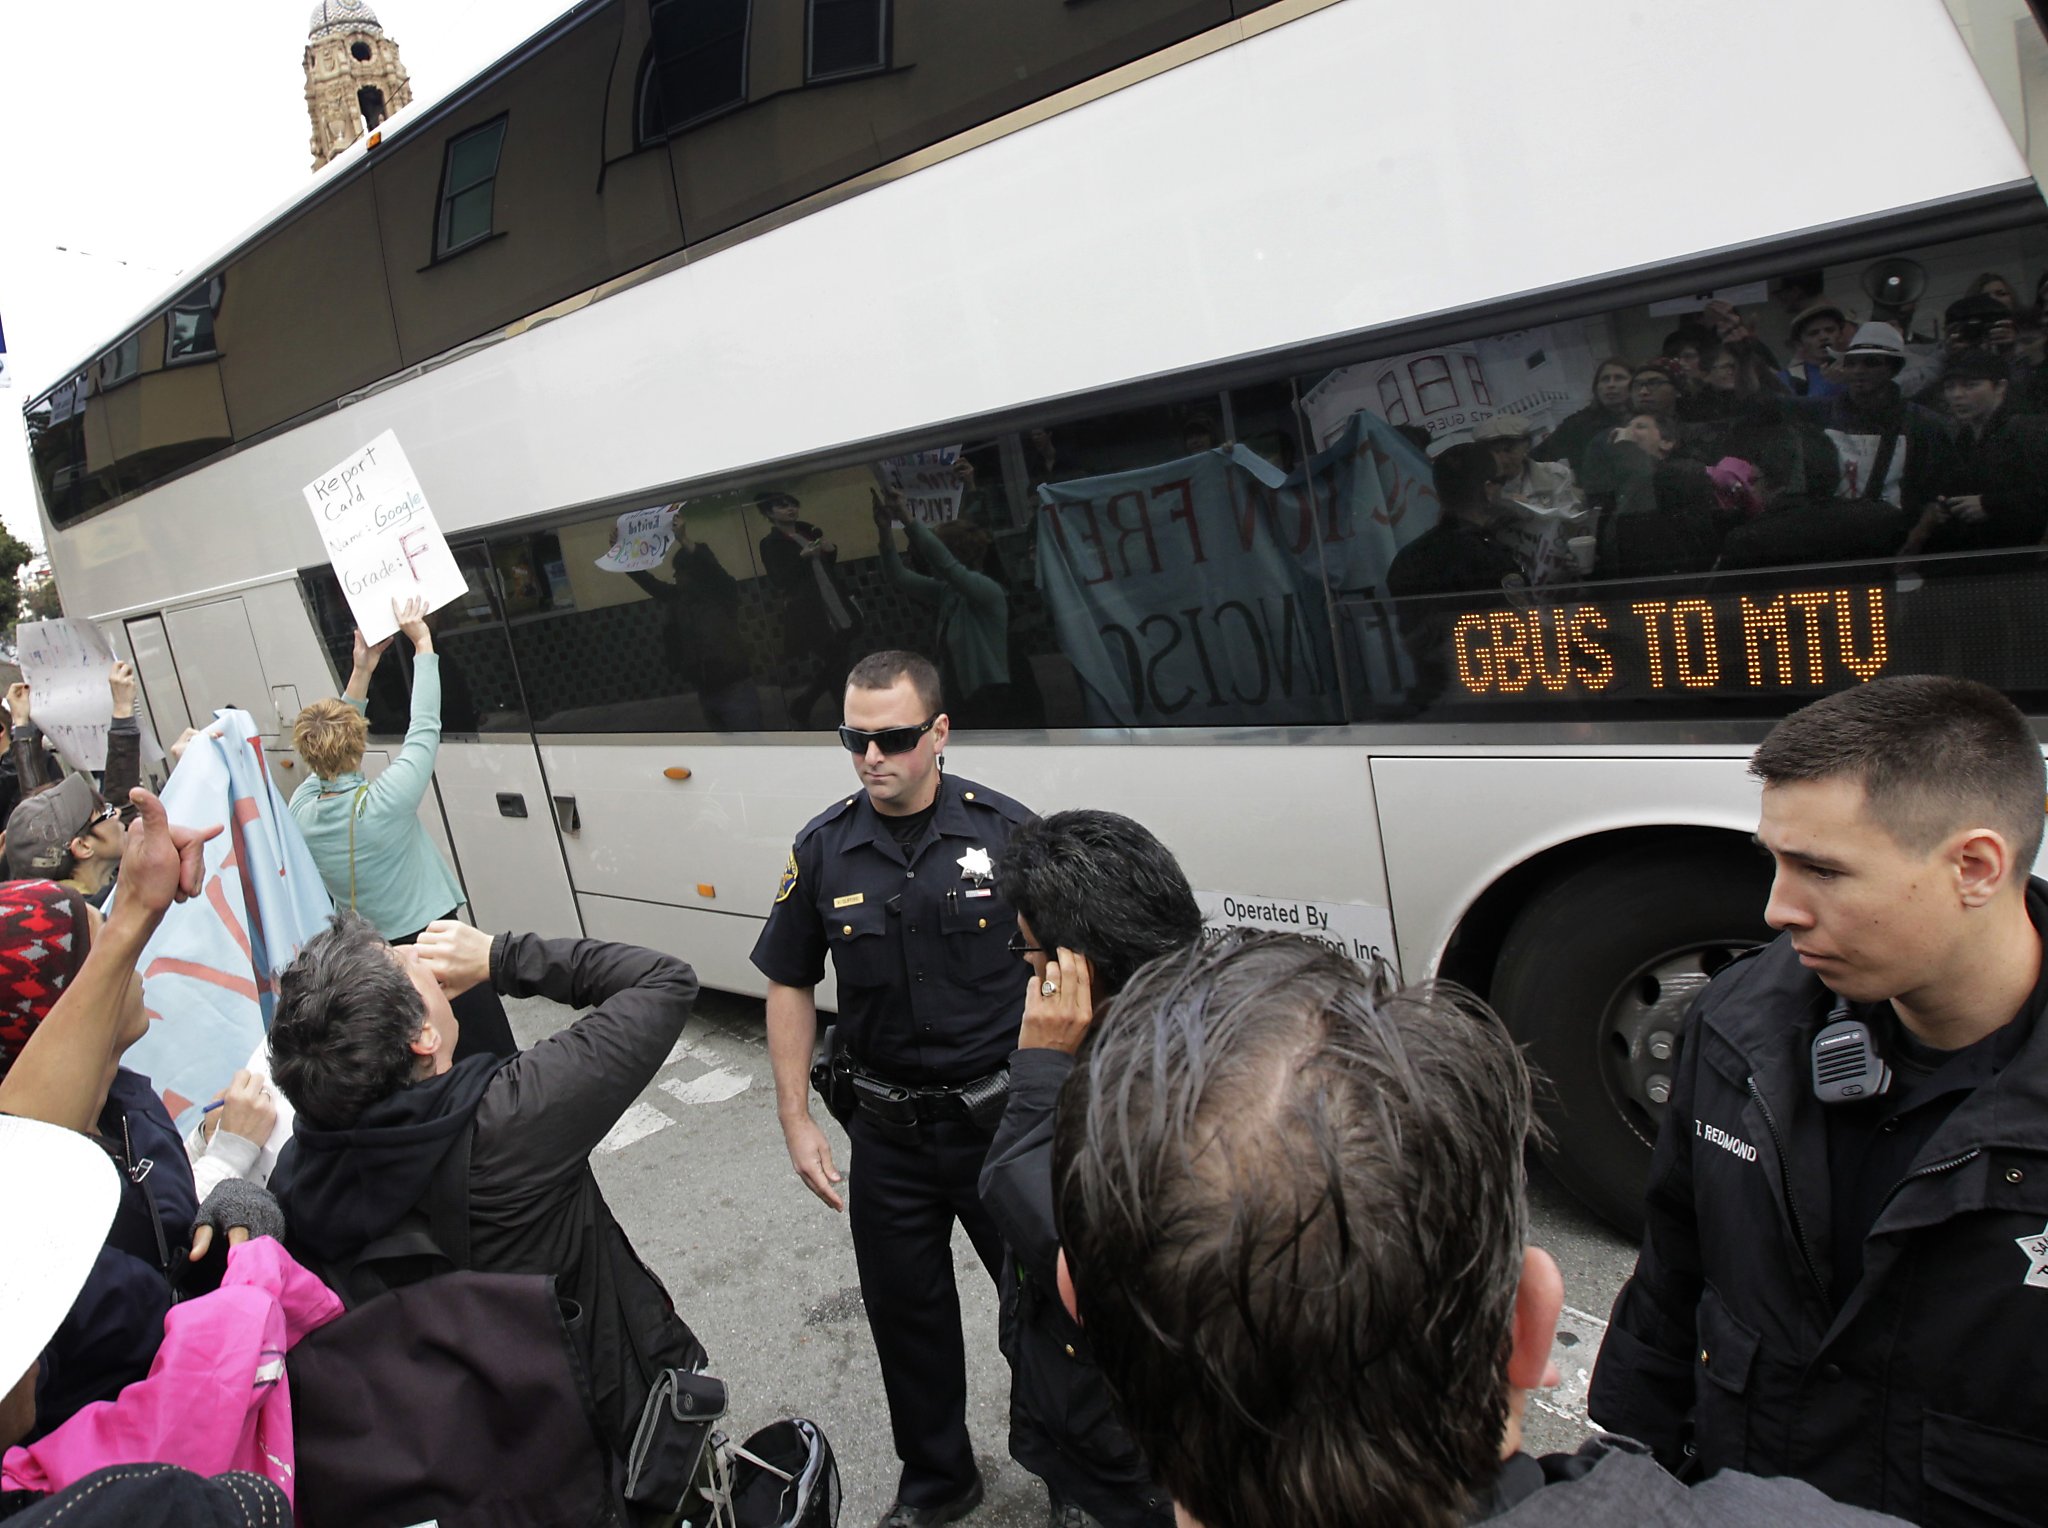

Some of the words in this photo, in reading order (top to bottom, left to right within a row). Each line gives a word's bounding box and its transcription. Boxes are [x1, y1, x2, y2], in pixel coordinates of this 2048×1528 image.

[313, 447, 376, 501] Report
[324, 484, 365, 522] Card
[374, 491, 421, 526] Google
[343, 557, 403, 596] Grade:
[399, 526, 430, 583] F
[1453, 606, 1615, 692] GBUS
[1631, 599, 1720, 688] TO
[1741, 587, 1888, 687] MTV
[1223, 897, 1300, 924] Operated
[1306, 905, 1328, 931] By
[1695, 1119, 1702, 1137] T.
[1704, 1124, 1757, 1162] REDMOND
